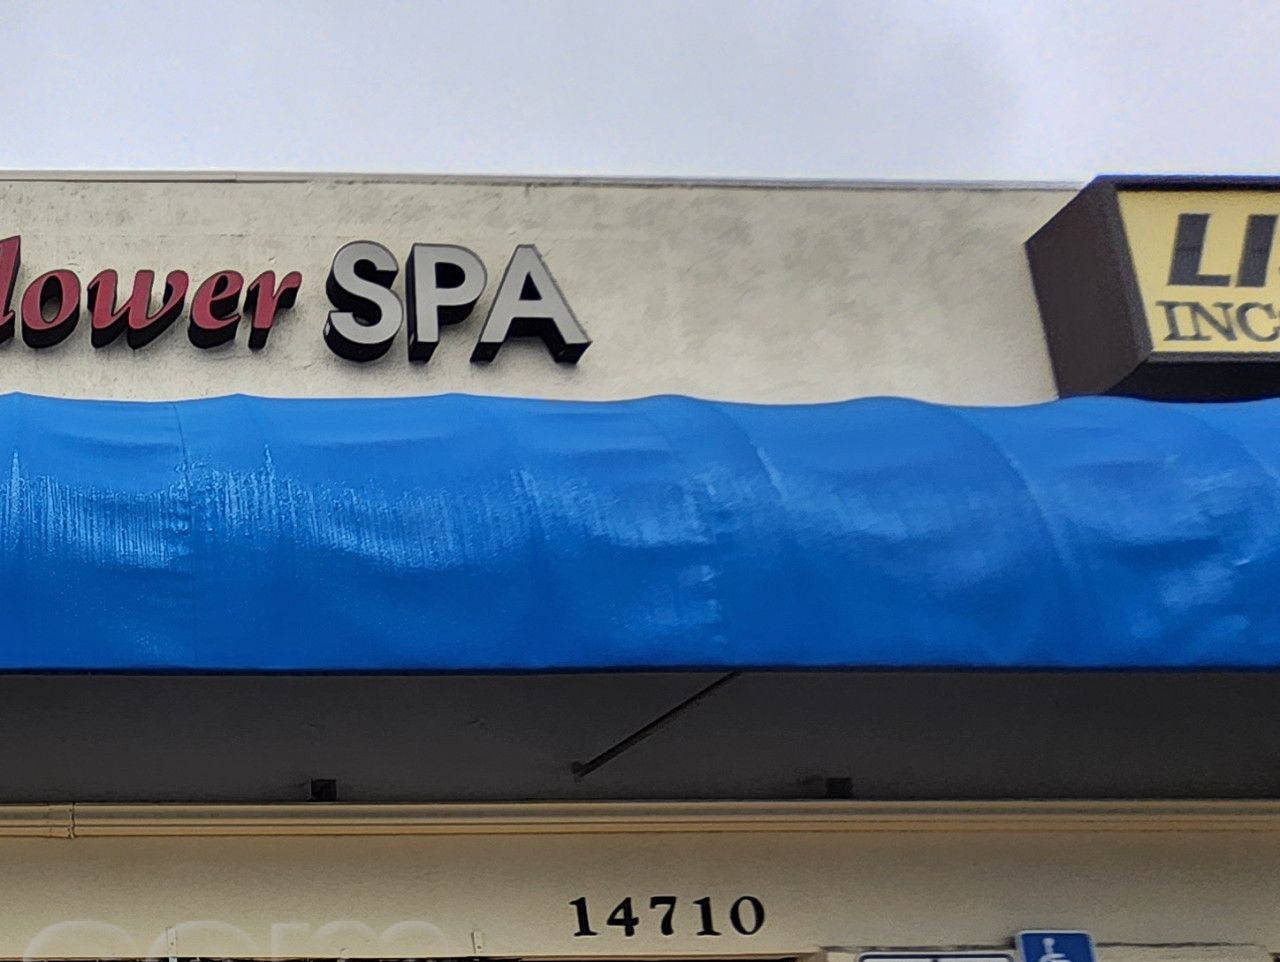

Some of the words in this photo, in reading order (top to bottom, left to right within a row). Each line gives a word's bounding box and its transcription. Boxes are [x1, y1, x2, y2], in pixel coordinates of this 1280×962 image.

[1167, 213, 1280, 288] LI
[324, 240, 592, 364] SPA
[1155, 300, 1280, 342] INC
[569, 895, 766, 938] 14710
